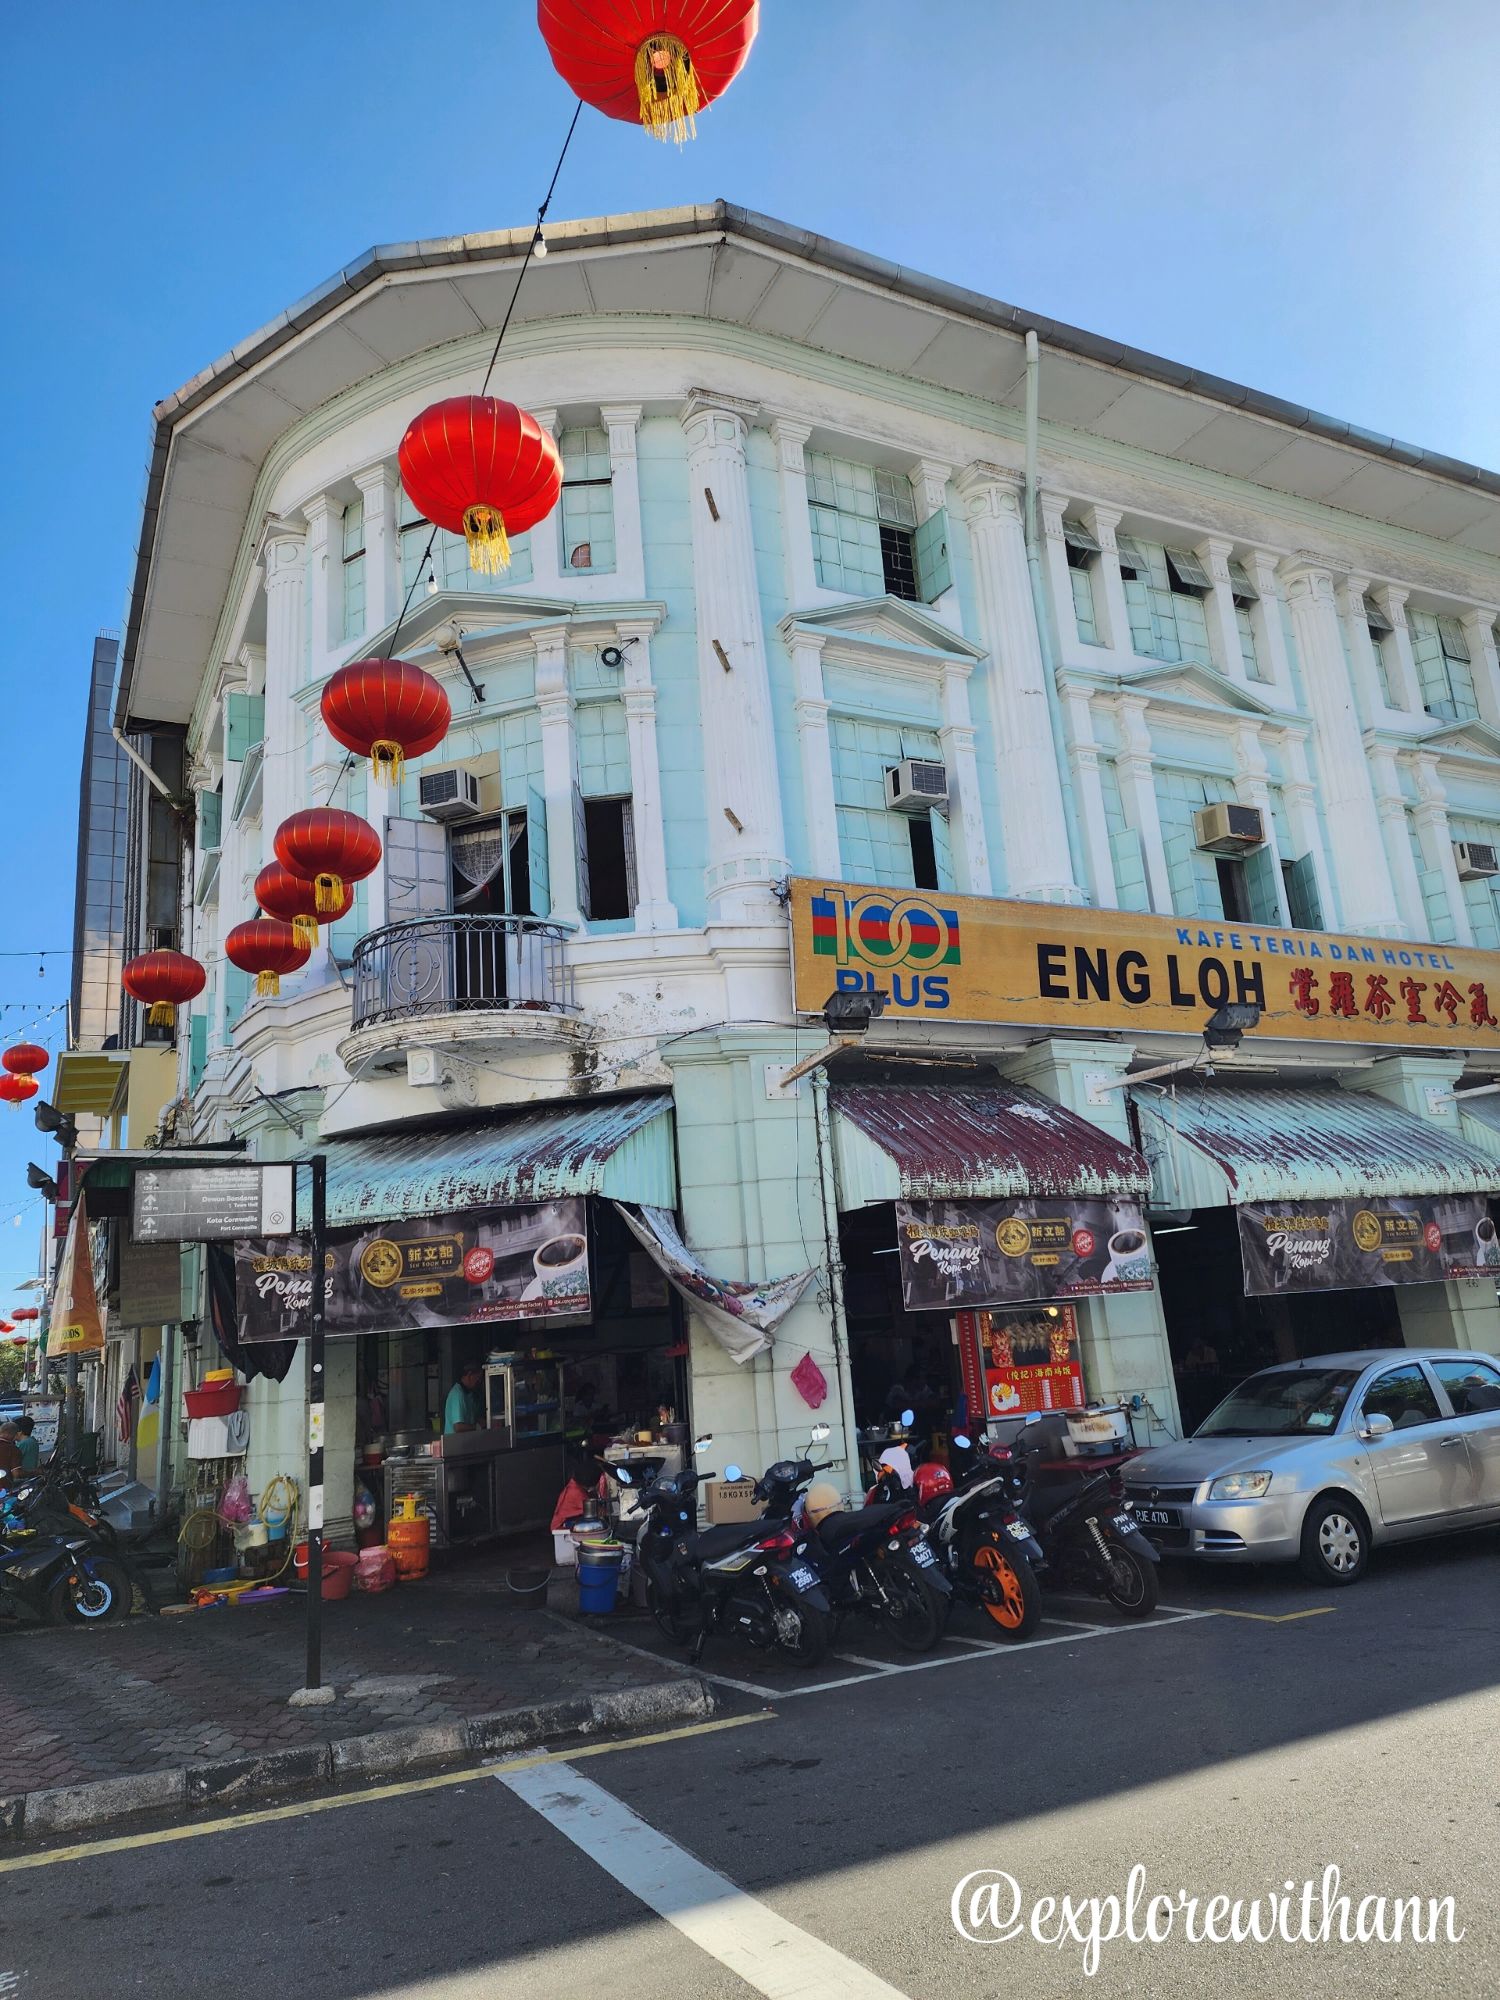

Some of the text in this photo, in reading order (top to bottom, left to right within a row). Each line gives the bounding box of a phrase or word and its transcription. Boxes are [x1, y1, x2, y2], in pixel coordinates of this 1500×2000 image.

[823, 888, 949, 970] 100
[1329, 944, 1376, 963] DAN
[1382, 950, 1454, 970] HOTEL
[836, 969, 950, 1009] PLUS
[1037, 943, 1267, 1012] ENG LOH
[909, 1239, 981, 1265] Penang
[1266, 1232, 1331, 1258] Penang
[937, 1261, 972, 1276] Kopi-o
[1291, 1255, 1323, 1269] Kopi-o
[255, 1273, 334, 1299] Penag
[728, 1491, 738, 1499] KG
[744, 1490, 749, 1498] 5
[1135, 1510, 1169, 1524] PJE 4710
[914, 1548, 932, 1564] 9407
